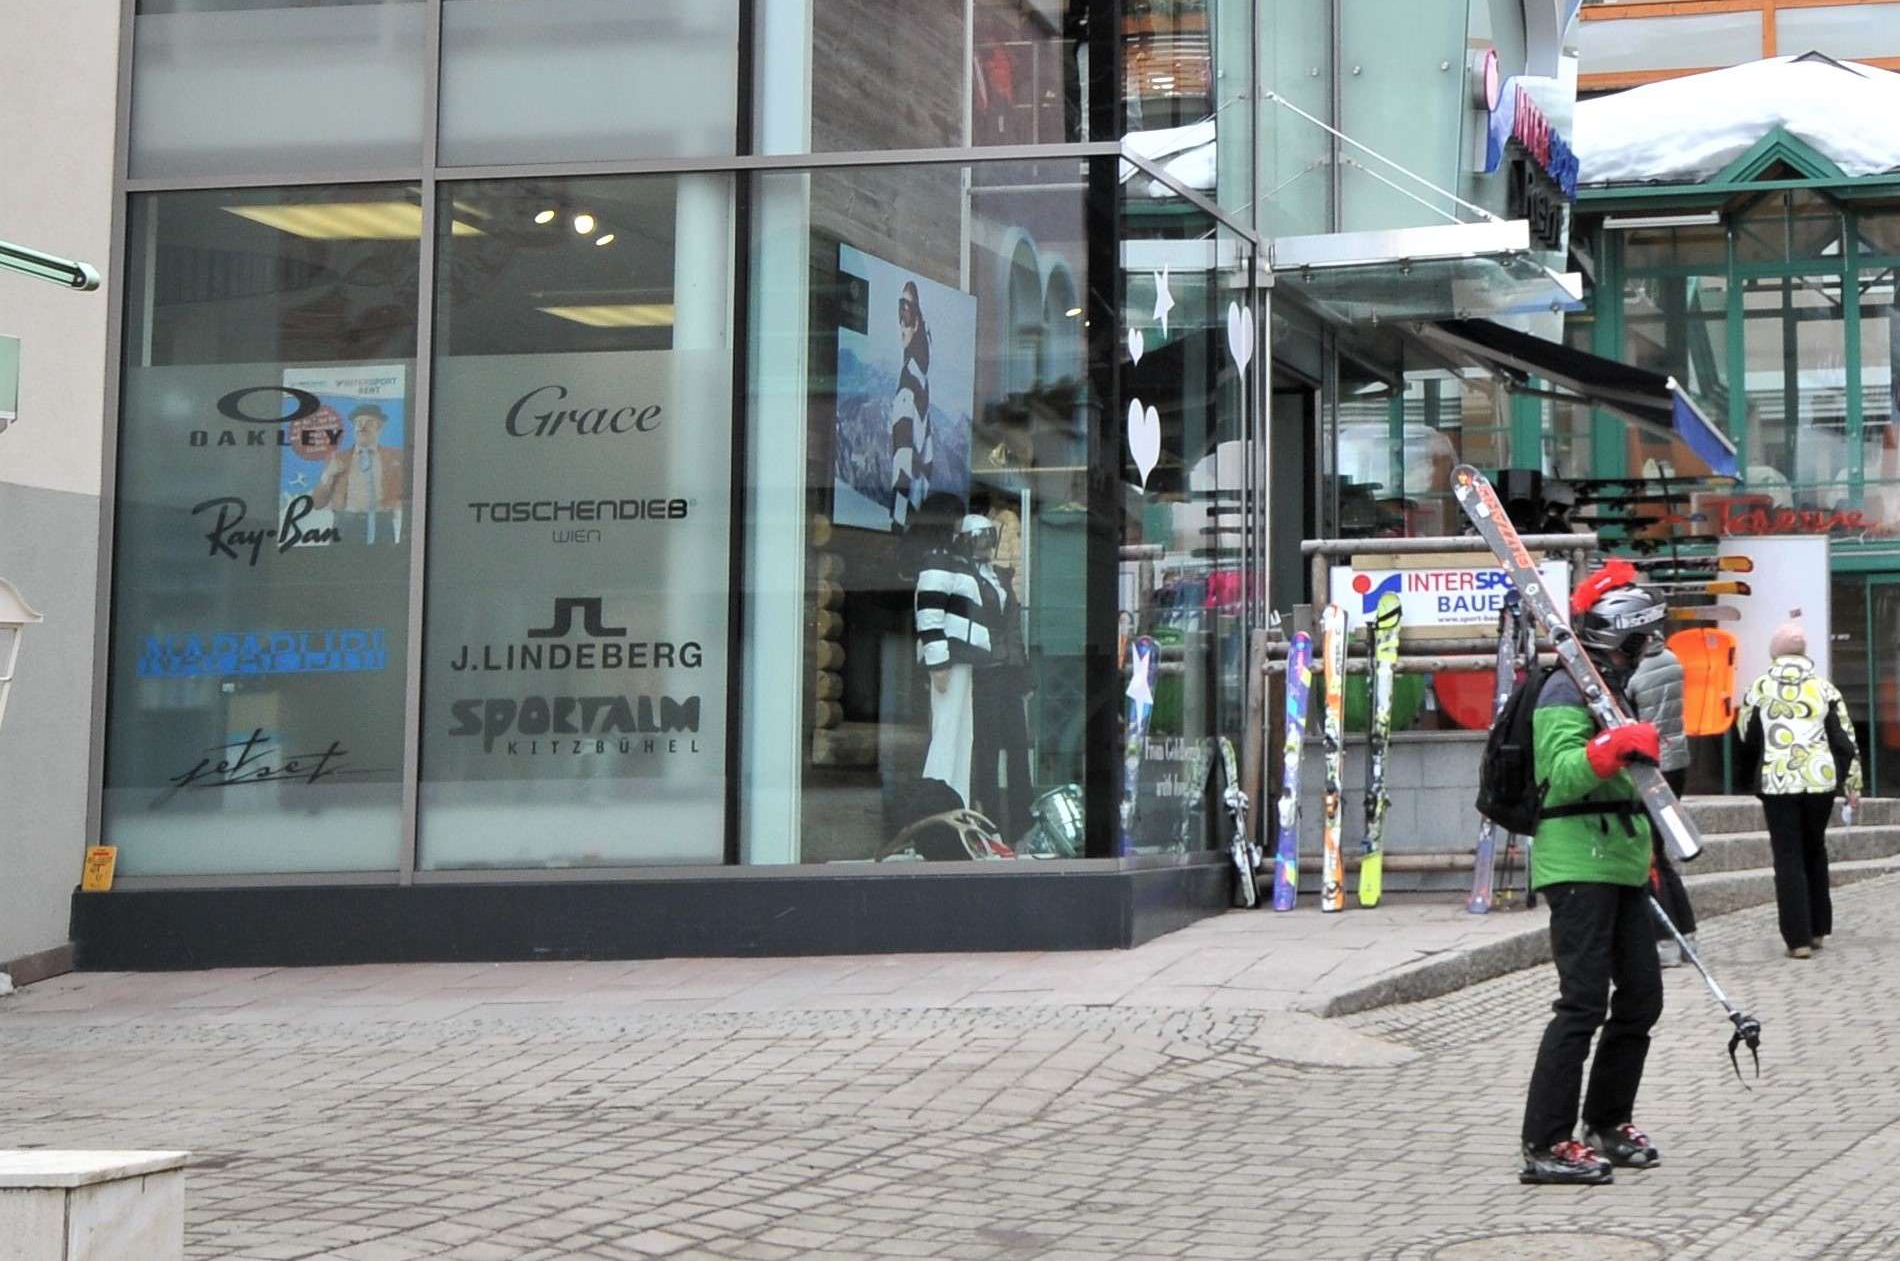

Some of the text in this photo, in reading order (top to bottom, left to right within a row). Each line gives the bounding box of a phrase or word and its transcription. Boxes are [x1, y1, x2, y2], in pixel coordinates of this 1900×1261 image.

[505, 384, 663, 438] Grace
[190, 429, 344, 447] OAKLEY
[191, 494, 343, 567] Ray-Ban
[1437, 594, 1506, 614] BAUE
[451, 641, 704, 672] J.LINDEBERG
[507, 739, 700, 755] KITZBÜHEL
